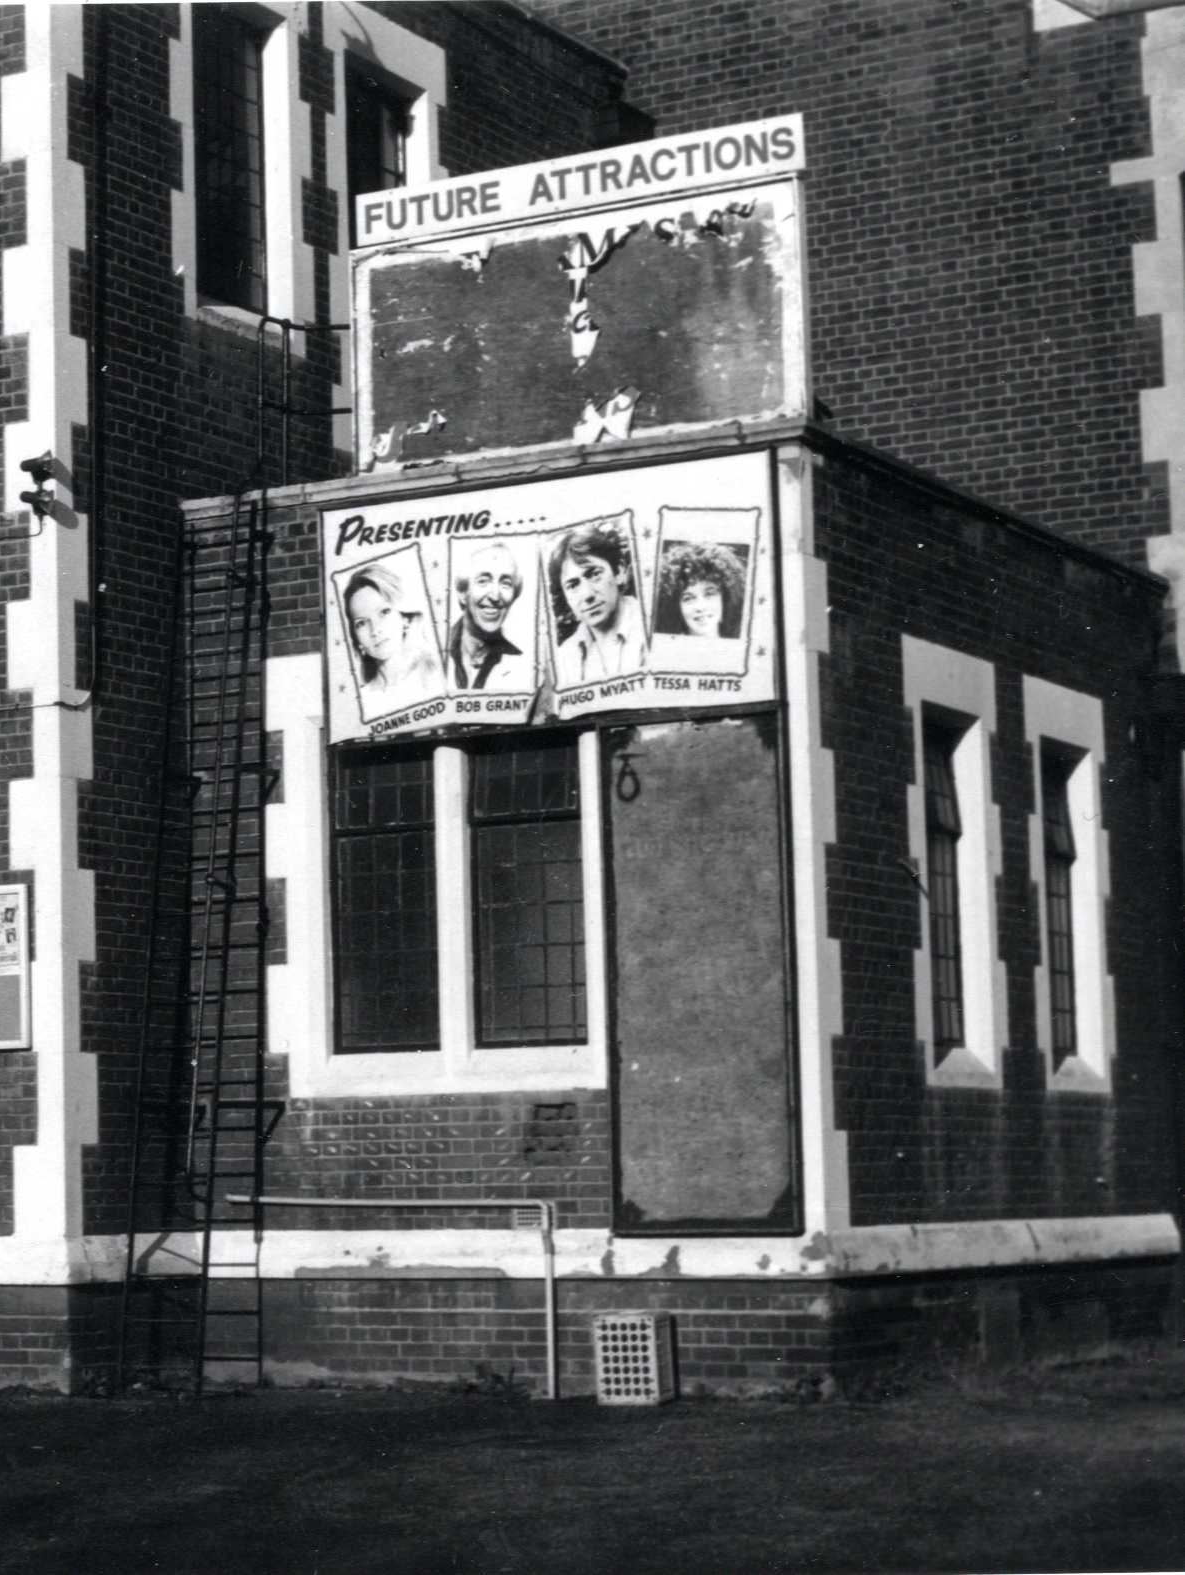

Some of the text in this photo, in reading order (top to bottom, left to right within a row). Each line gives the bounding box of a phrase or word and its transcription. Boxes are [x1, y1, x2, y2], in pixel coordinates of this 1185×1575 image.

[363, 126, 796, 235] FUTURE ATTRACTIONS
[558, 676, 742, 711] HUGO MYATT TESSA HATTS
[368, 698, 531, 738] JOANNE GOOD BOB GRANT
